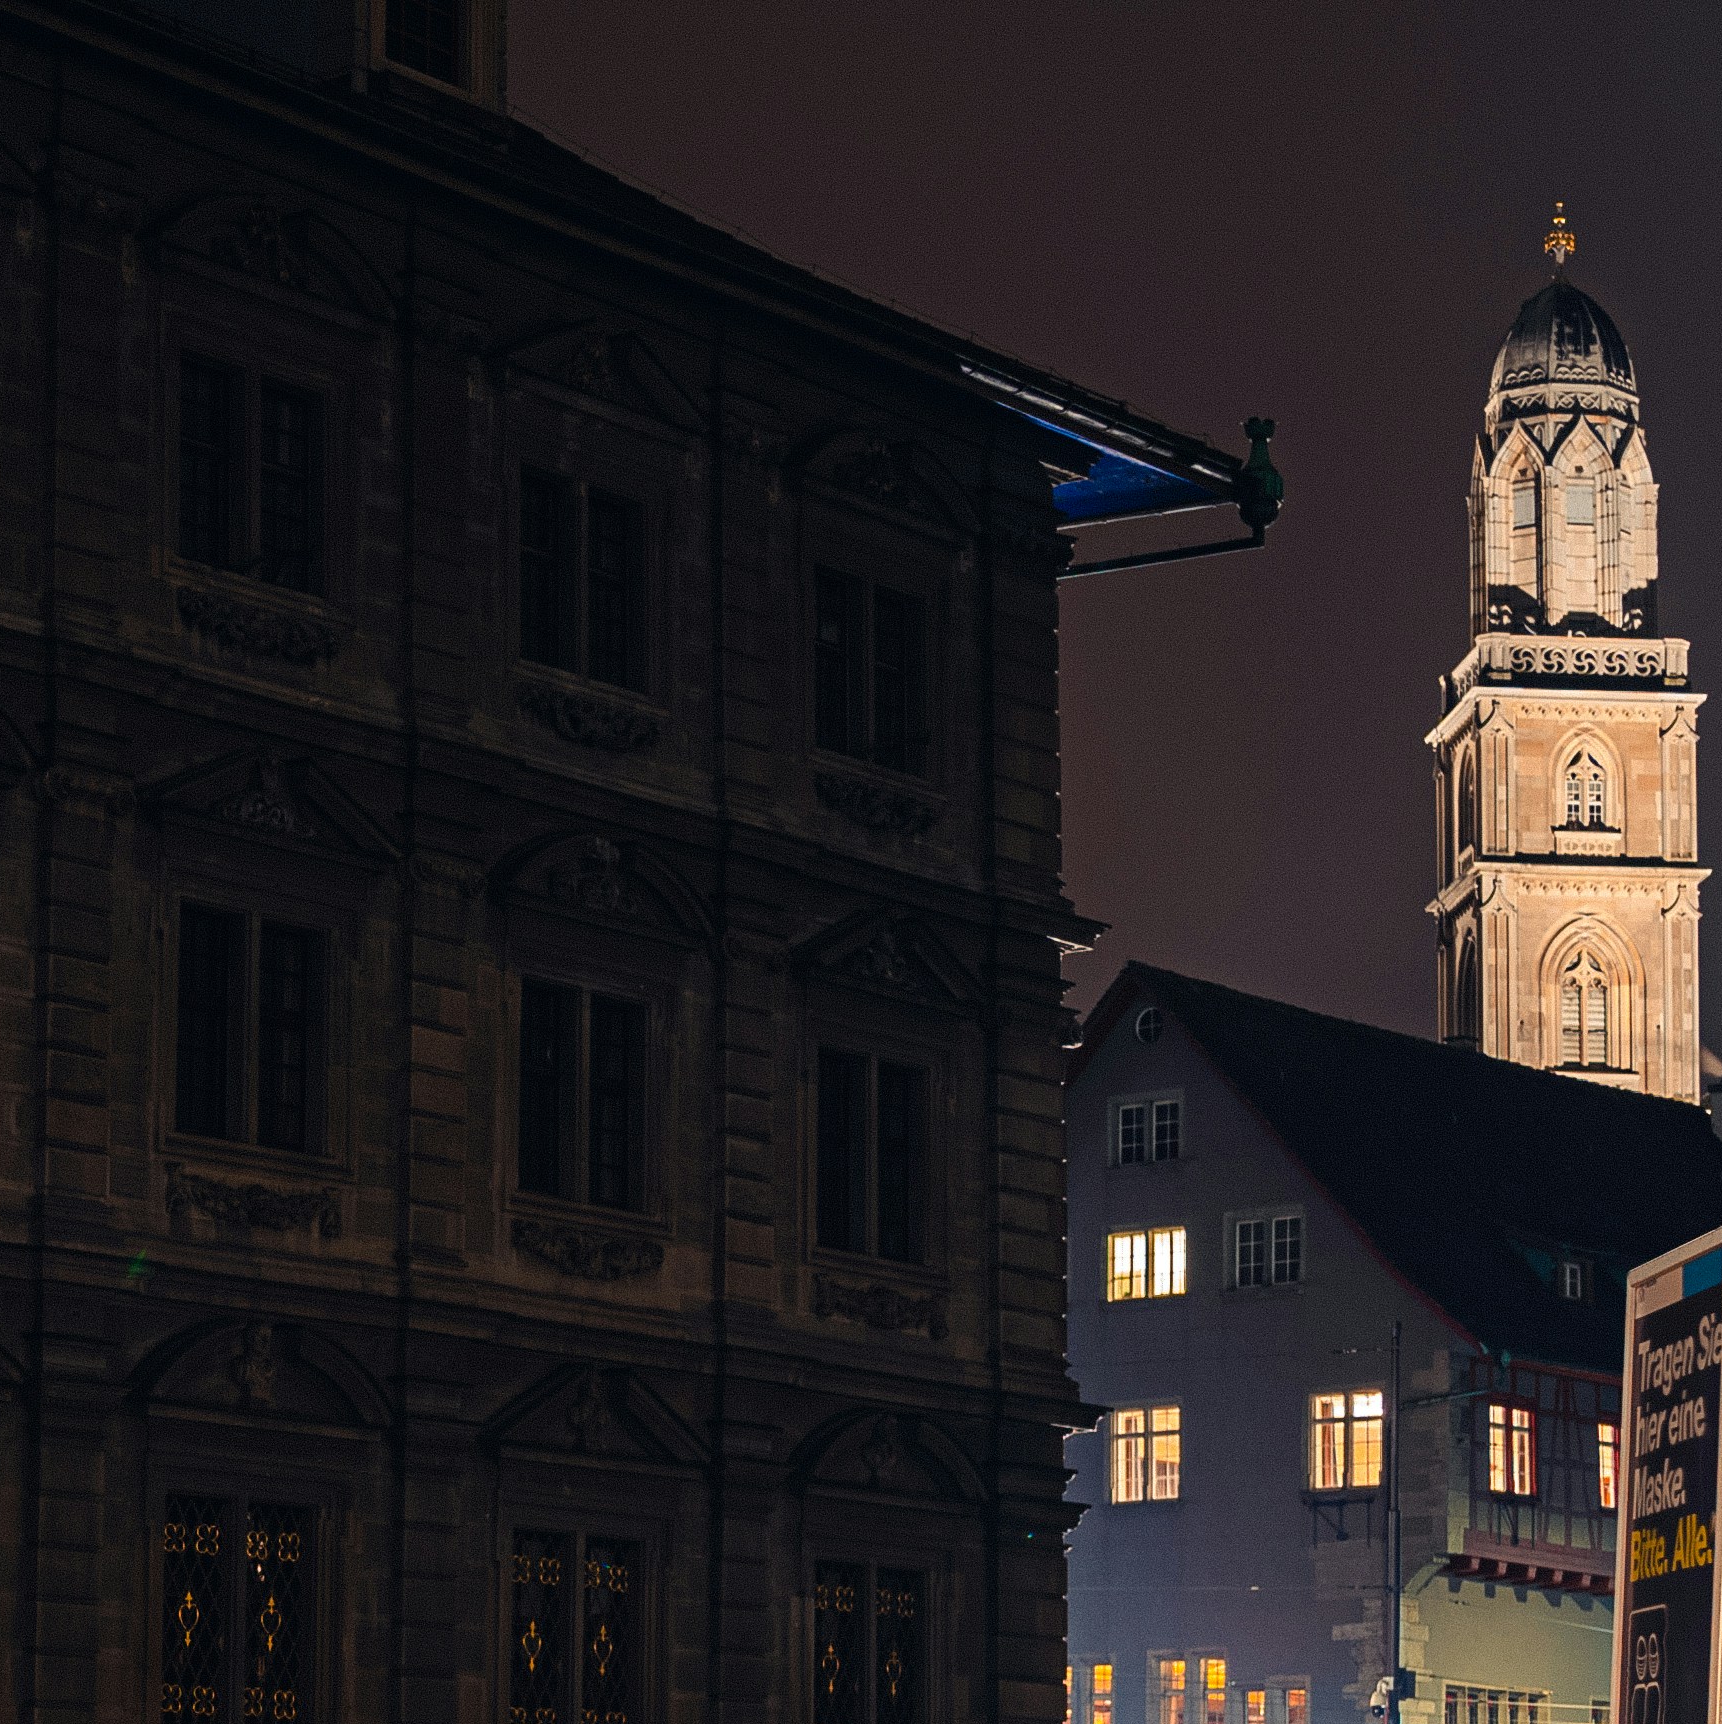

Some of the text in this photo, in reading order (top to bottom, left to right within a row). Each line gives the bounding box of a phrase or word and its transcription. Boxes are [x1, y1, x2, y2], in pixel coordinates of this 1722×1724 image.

[1638, 1313, 1722, 1396] Tragen Sie
[1634, 1389, 1706, 1458] hier eine
[1632, 1457, 1686, 1520] Maske.
[1630, 1513, 1713, 1582] Bitte. Alle.
